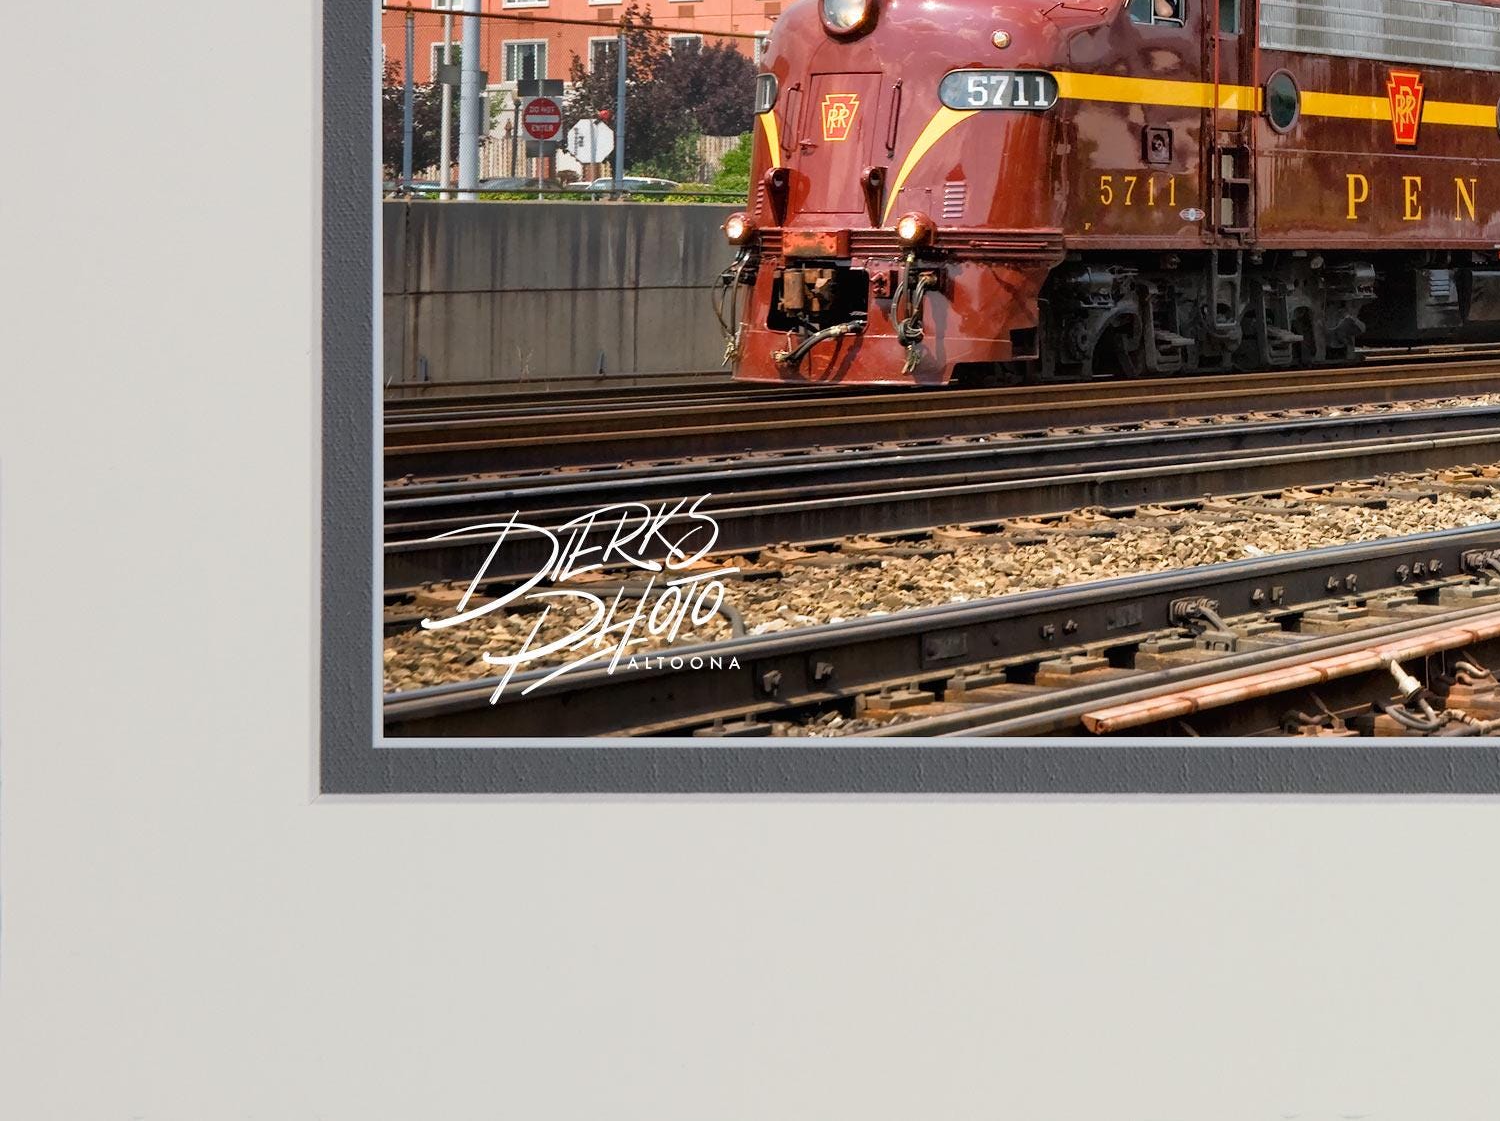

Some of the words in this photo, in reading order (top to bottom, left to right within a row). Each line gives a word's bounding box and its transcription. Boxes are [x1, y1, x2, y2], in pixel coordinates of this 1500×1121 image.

[967, 76, 1049, 106] 5711
[531, 124, 554, 132] ENTER
[1100, 175, 1176, 206] 5711
